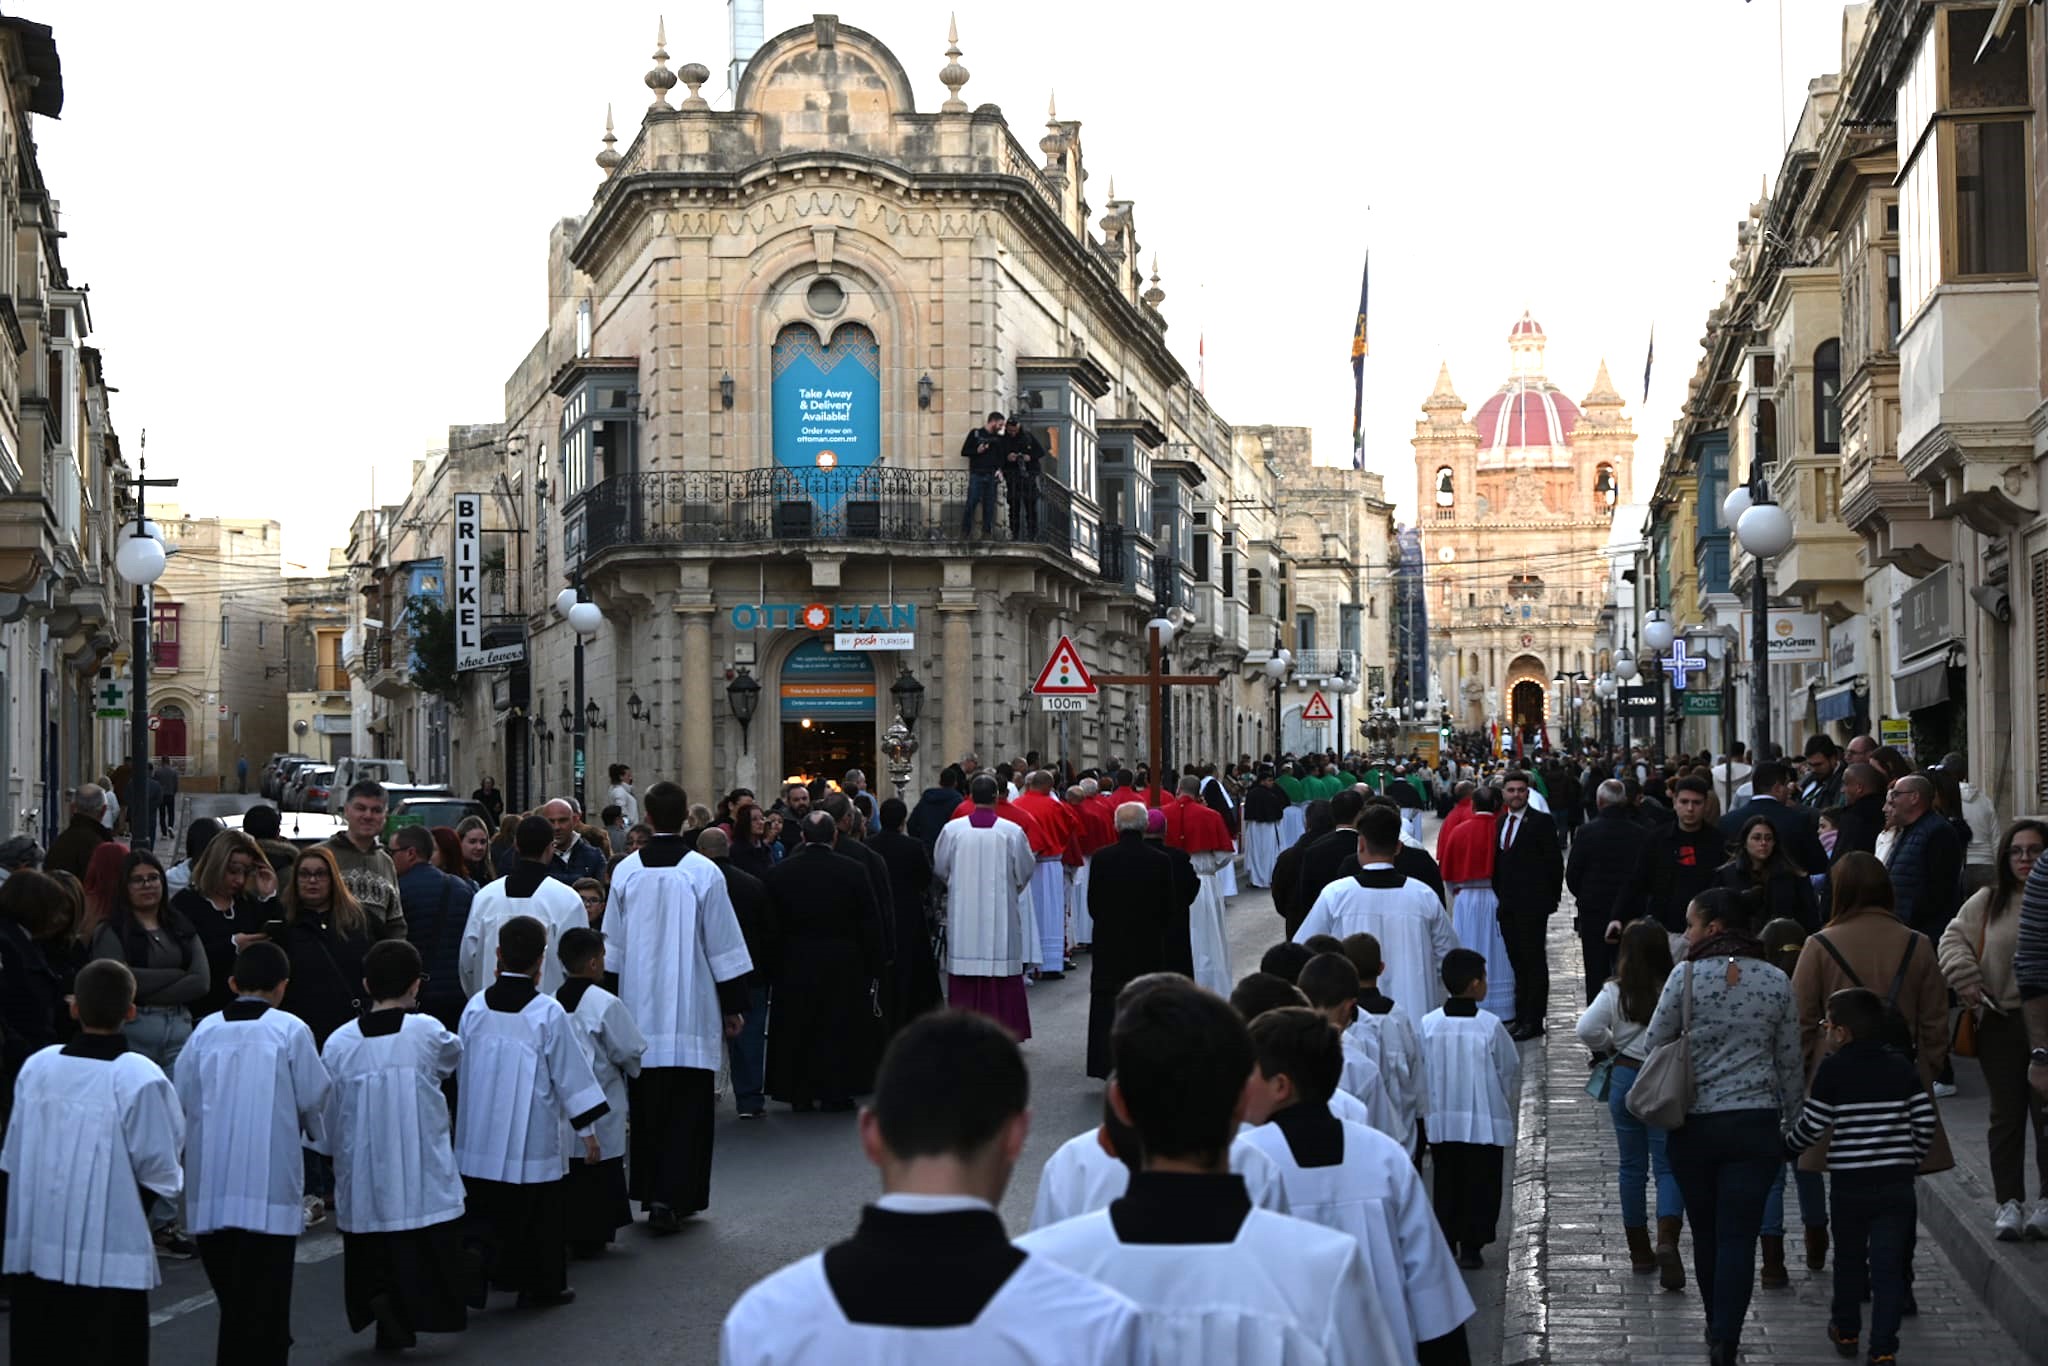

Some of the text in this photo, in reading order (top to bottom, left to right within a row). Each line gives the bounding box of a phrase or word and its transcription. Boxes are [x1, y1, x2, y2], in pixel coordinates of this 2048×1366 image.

[799, 388, 853, 401] Take Away
[799, 400, 853, 412] & Delivery
[801, 411, 850, 421] Available!
[458, 500, 476, 648] BRITKEL
[731, 603, 918, 631] OTTOMAN
[841, 634, 910, 648] BY posh TURKISH
[1749, 637, 1816, 649] neyGram
[458, 651, 524, 669] shoe lovers
[1048, 697, 1082, 709] 100m
[1690, 696, 1717, 707] POYC
